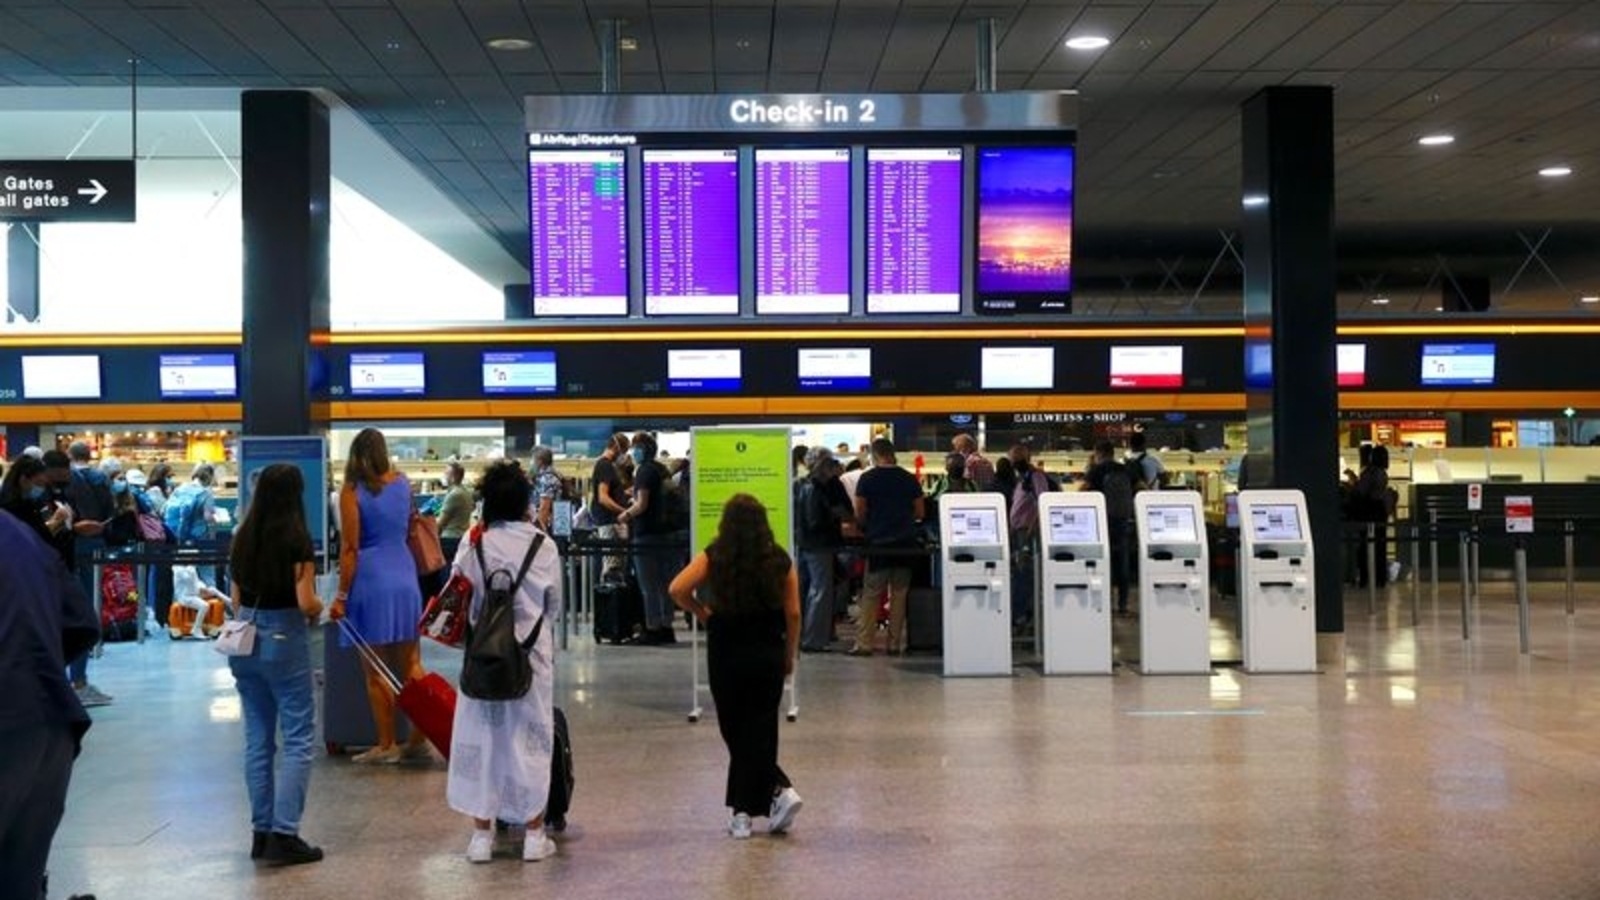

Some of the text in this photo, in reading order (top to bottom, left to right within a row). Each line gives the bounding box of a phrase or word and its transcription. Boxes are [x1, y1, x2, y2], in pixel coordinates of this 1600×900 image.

[730, 99, 876, 122] Check-in 2
[4, 176, 54, 191] Gates
[23, 193, 70, 209] gates
[1093, 412, 1127, 422] SHOP
